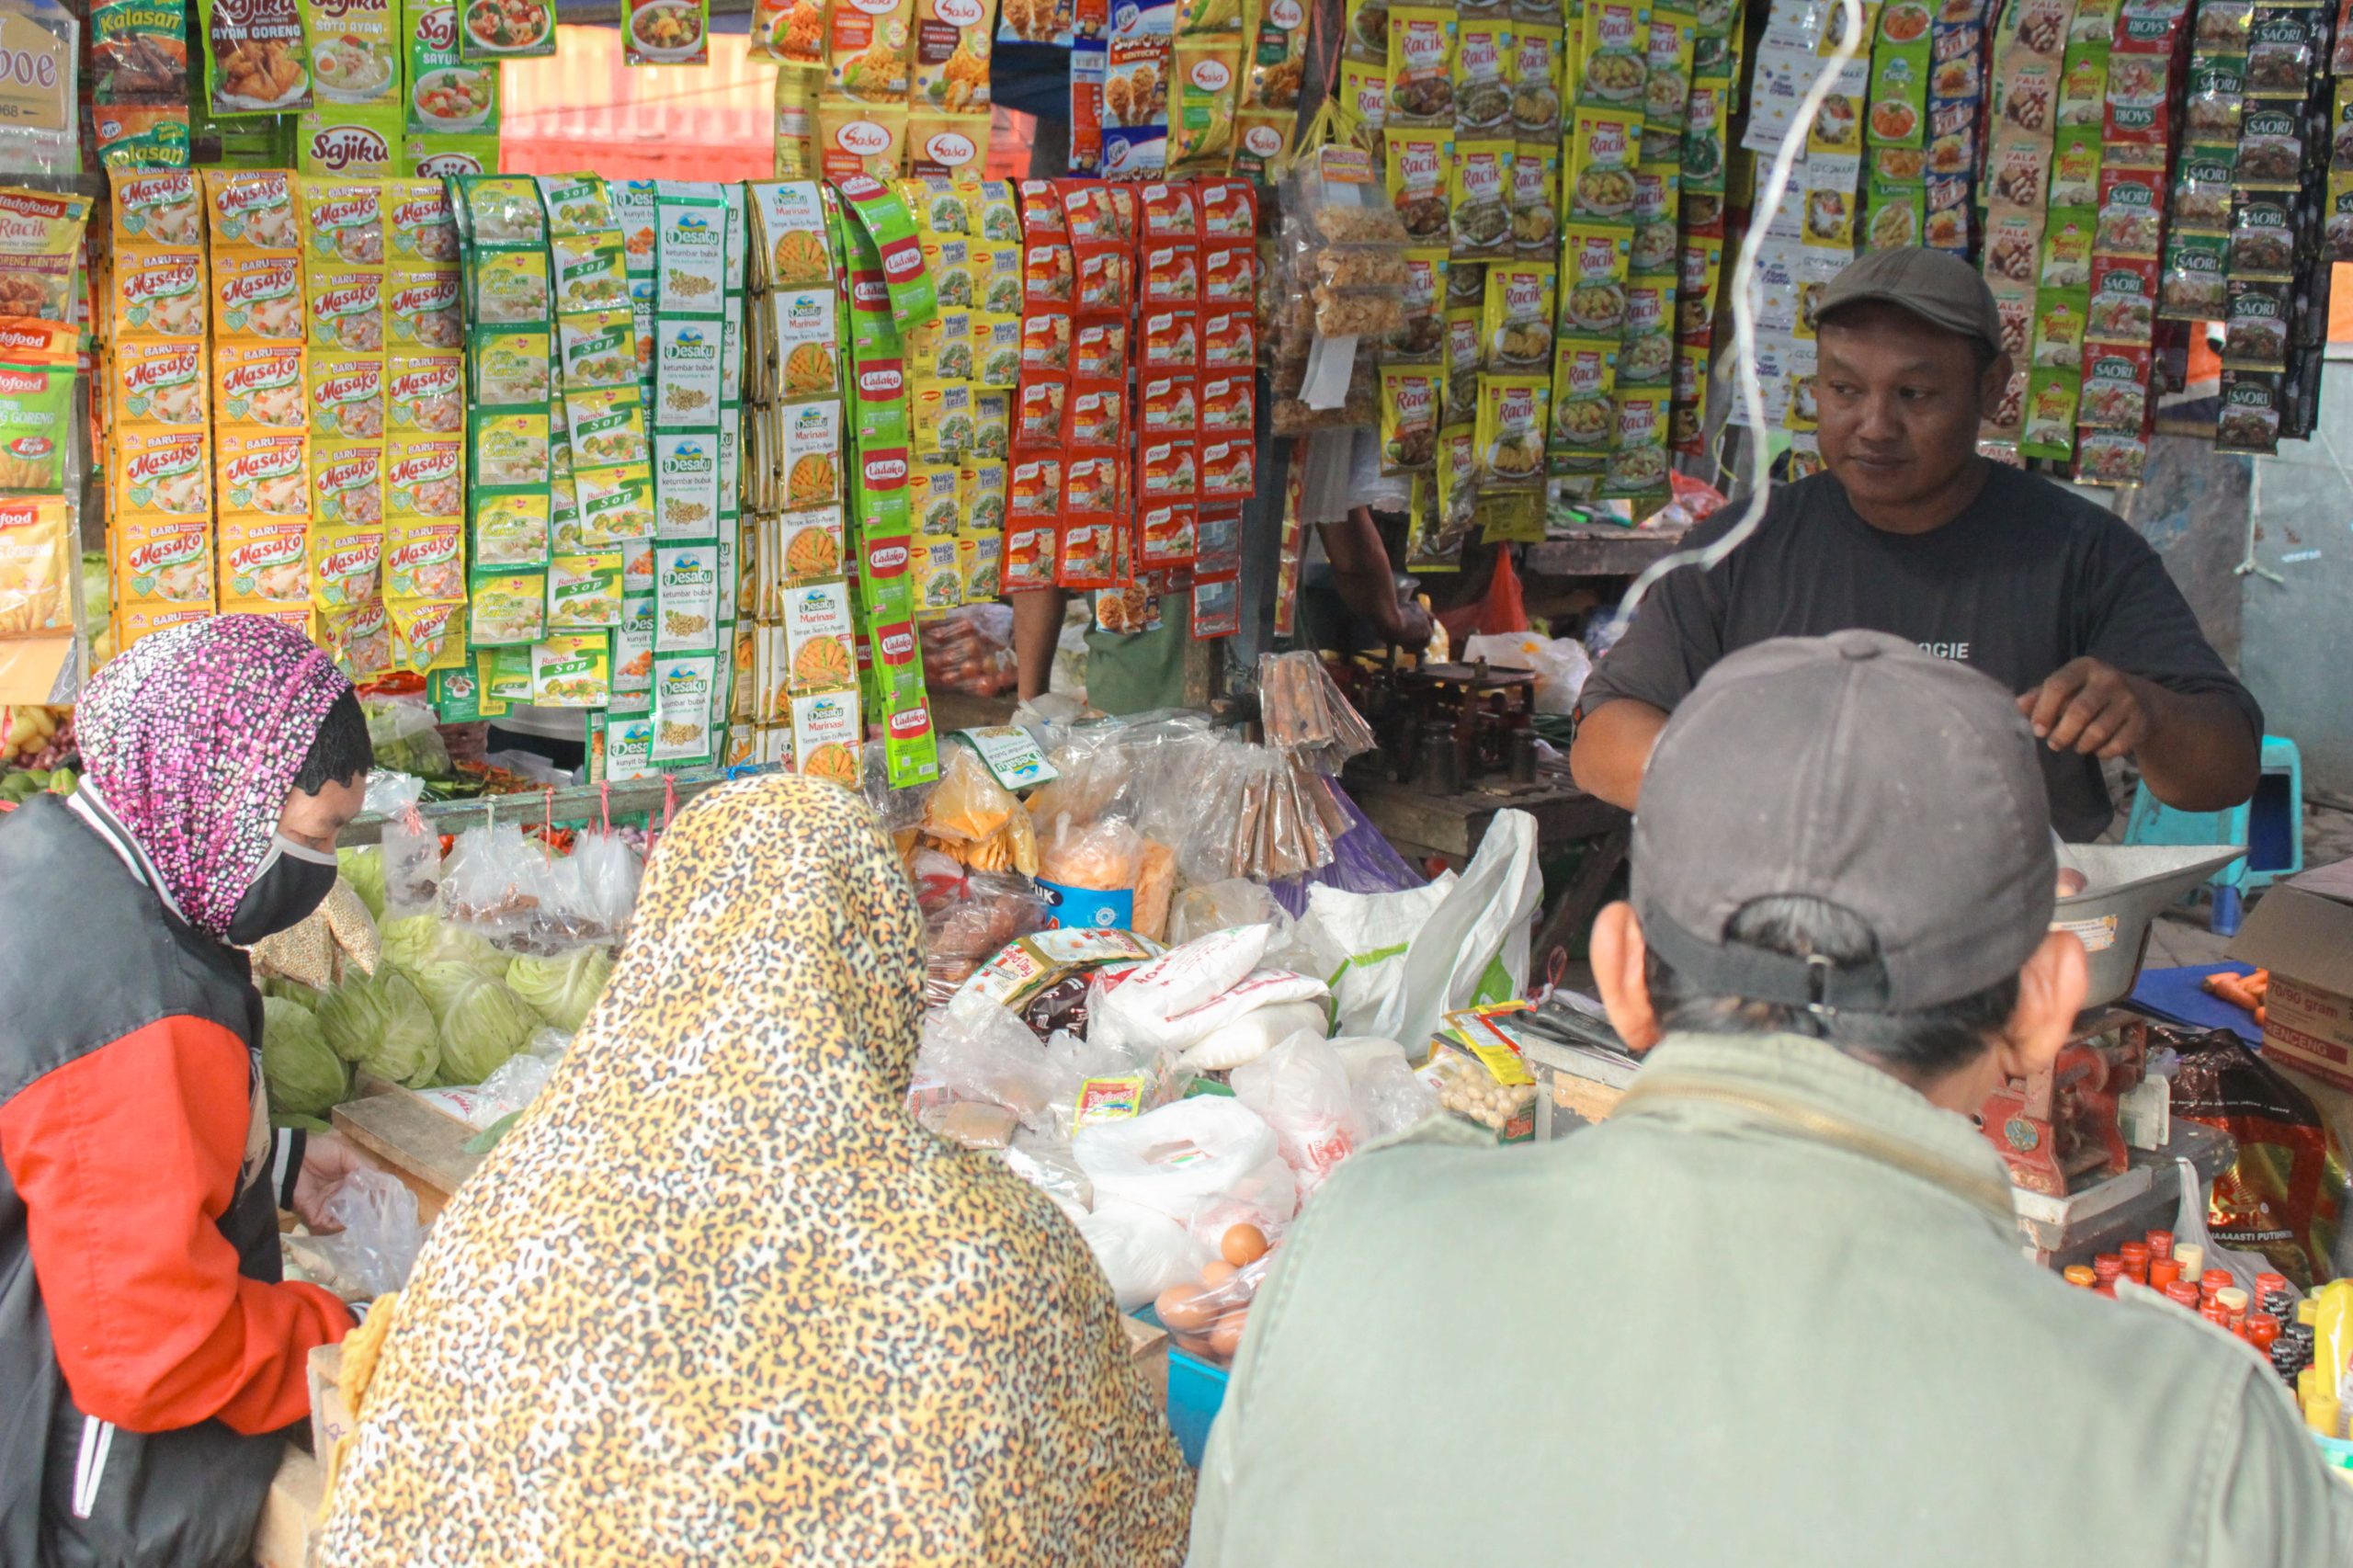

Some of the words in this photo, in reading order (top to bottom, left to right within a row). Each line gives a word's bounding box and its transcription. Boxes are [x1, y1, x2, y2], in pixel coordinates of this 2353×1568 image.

[100, 9, 182, 34] Kalasan
[316, 20, 347, 32] SOTO
[2129, 19, 2165, 34] SAORI
[212, 27, 247, 40] AYAM
[252, 23, 301, 39] GORENG
[2260, 28, 2301, 41] SAORI
[1404, 34, 1444, 57] Racik
[1461, 47, 1499, 69] Racik
[1518, 51, 1551, 70] Racik
[2116, 107, 2153, 122] SAORI
[2250, 119, 2290, 133] SAORI
[105, 144, 184, 167] Kalasan
[310, 133, 390, 171] Sajiku
[1401, 151, 1440, 173] Racik
[1463, 165, 1501, 187] Racik
[2189, 166, 2227, 182] SAORI
[617, 192, 655, 206] Desa
[2110, 191, 2150, 203] SAORI
[313, 196, 376, 226] Masako
[666, 231, 719, 246] Desaku
[143, 255, 172, 267] BARU
[241, 259, 270, 272] BARU
[888, 252, 920, 270] Ladaku
[1580, 250, 1616, 267] Racik
[2177, 256, 2217, 271] SAORI
[123, 263, 193, 296] Masako
[222, 267, 292, 299] Masako
[331, 274, 357, 287] BARU
[2104, 278, 2141, 290] SAORI
[313, 283, 377, 314] Masako
[390, 282, 455, 312] Masako
[1999, 303, 2025, 312] ALA
[2234, 301, 2276, 315] SAORI
[789, 318, 822, 330] Marinasi
[571, 334, 597, 347] Bumbu
[144, 345, 173, 357] BARU
[244, 347, 273, 360] BARU
[665, 344, 716, 360] Desaku
[125, 354, 196, 385] Masako
[332, 362, 358, 374] BARU
[408, 357, 434, 369] BARU
[2096, 363, 2134, 378] SAORI
[223, 357, 296, 389] Masako
[864, 371, 899, 388] Ladaku
[314, 371, 378, 403] Masako
[390, 367, 456, 397] Masako
[944, 387, 968, 398] Magic
[2232, 392, 2269, 405] SAORI
[577, 412, 605, 423] Bumbu
[1500, 402, 1537, 422] Racik
[1618, 415, 1657, 433] Racik
[147, 435, 176, 447] BARU
[246, 437, 275, 449] BARU
[795, 431, 829, 442] Marinasi
[333, 449, 358, 460] BARU
[408, 443, 435, 454] BARU
[128, 443, 199, 476] Masako
[226, 446, 298, 479] Masako
[390, 451, 455, 483] Masako
[663, 457, 712, 474] Desaku
[317, 457, 376, 490] Masako
[869, 460, 904, 477] Ladaku
[586, 487, 615, 501] Bumbu
[150, 525, 179, 538] BARU
[249, 525, 278, 538] BARU
[408, 528, 433, 539] BARU
[335, 536, 359, 548] BARU
[129, 533, 200, 567] Masako
[230, 534, 301, 567] Masako
[389, 534, 454, 567] Masako
[872, 550, 904, 563] Ladaku
[320, 542, 380, 576] Masako
[558, 575, 585, 586] Bumbu
[663, 569, 713, 587] Desaku
[153, 612, 182, 626] BARU
[800, 613, 836, 623] Marinasi
[884, 635, 913, 653] Ladaku
[541, 654, 570, 666] Bumbu
[661, 679, 708, 697] Desaku
[894, 707, 927, 726] Ladaku
[808, 721, 845, 732] Marinasi
[611, 743, 647, 758] Desa
[2304, 998, 2338, 1019] gram
